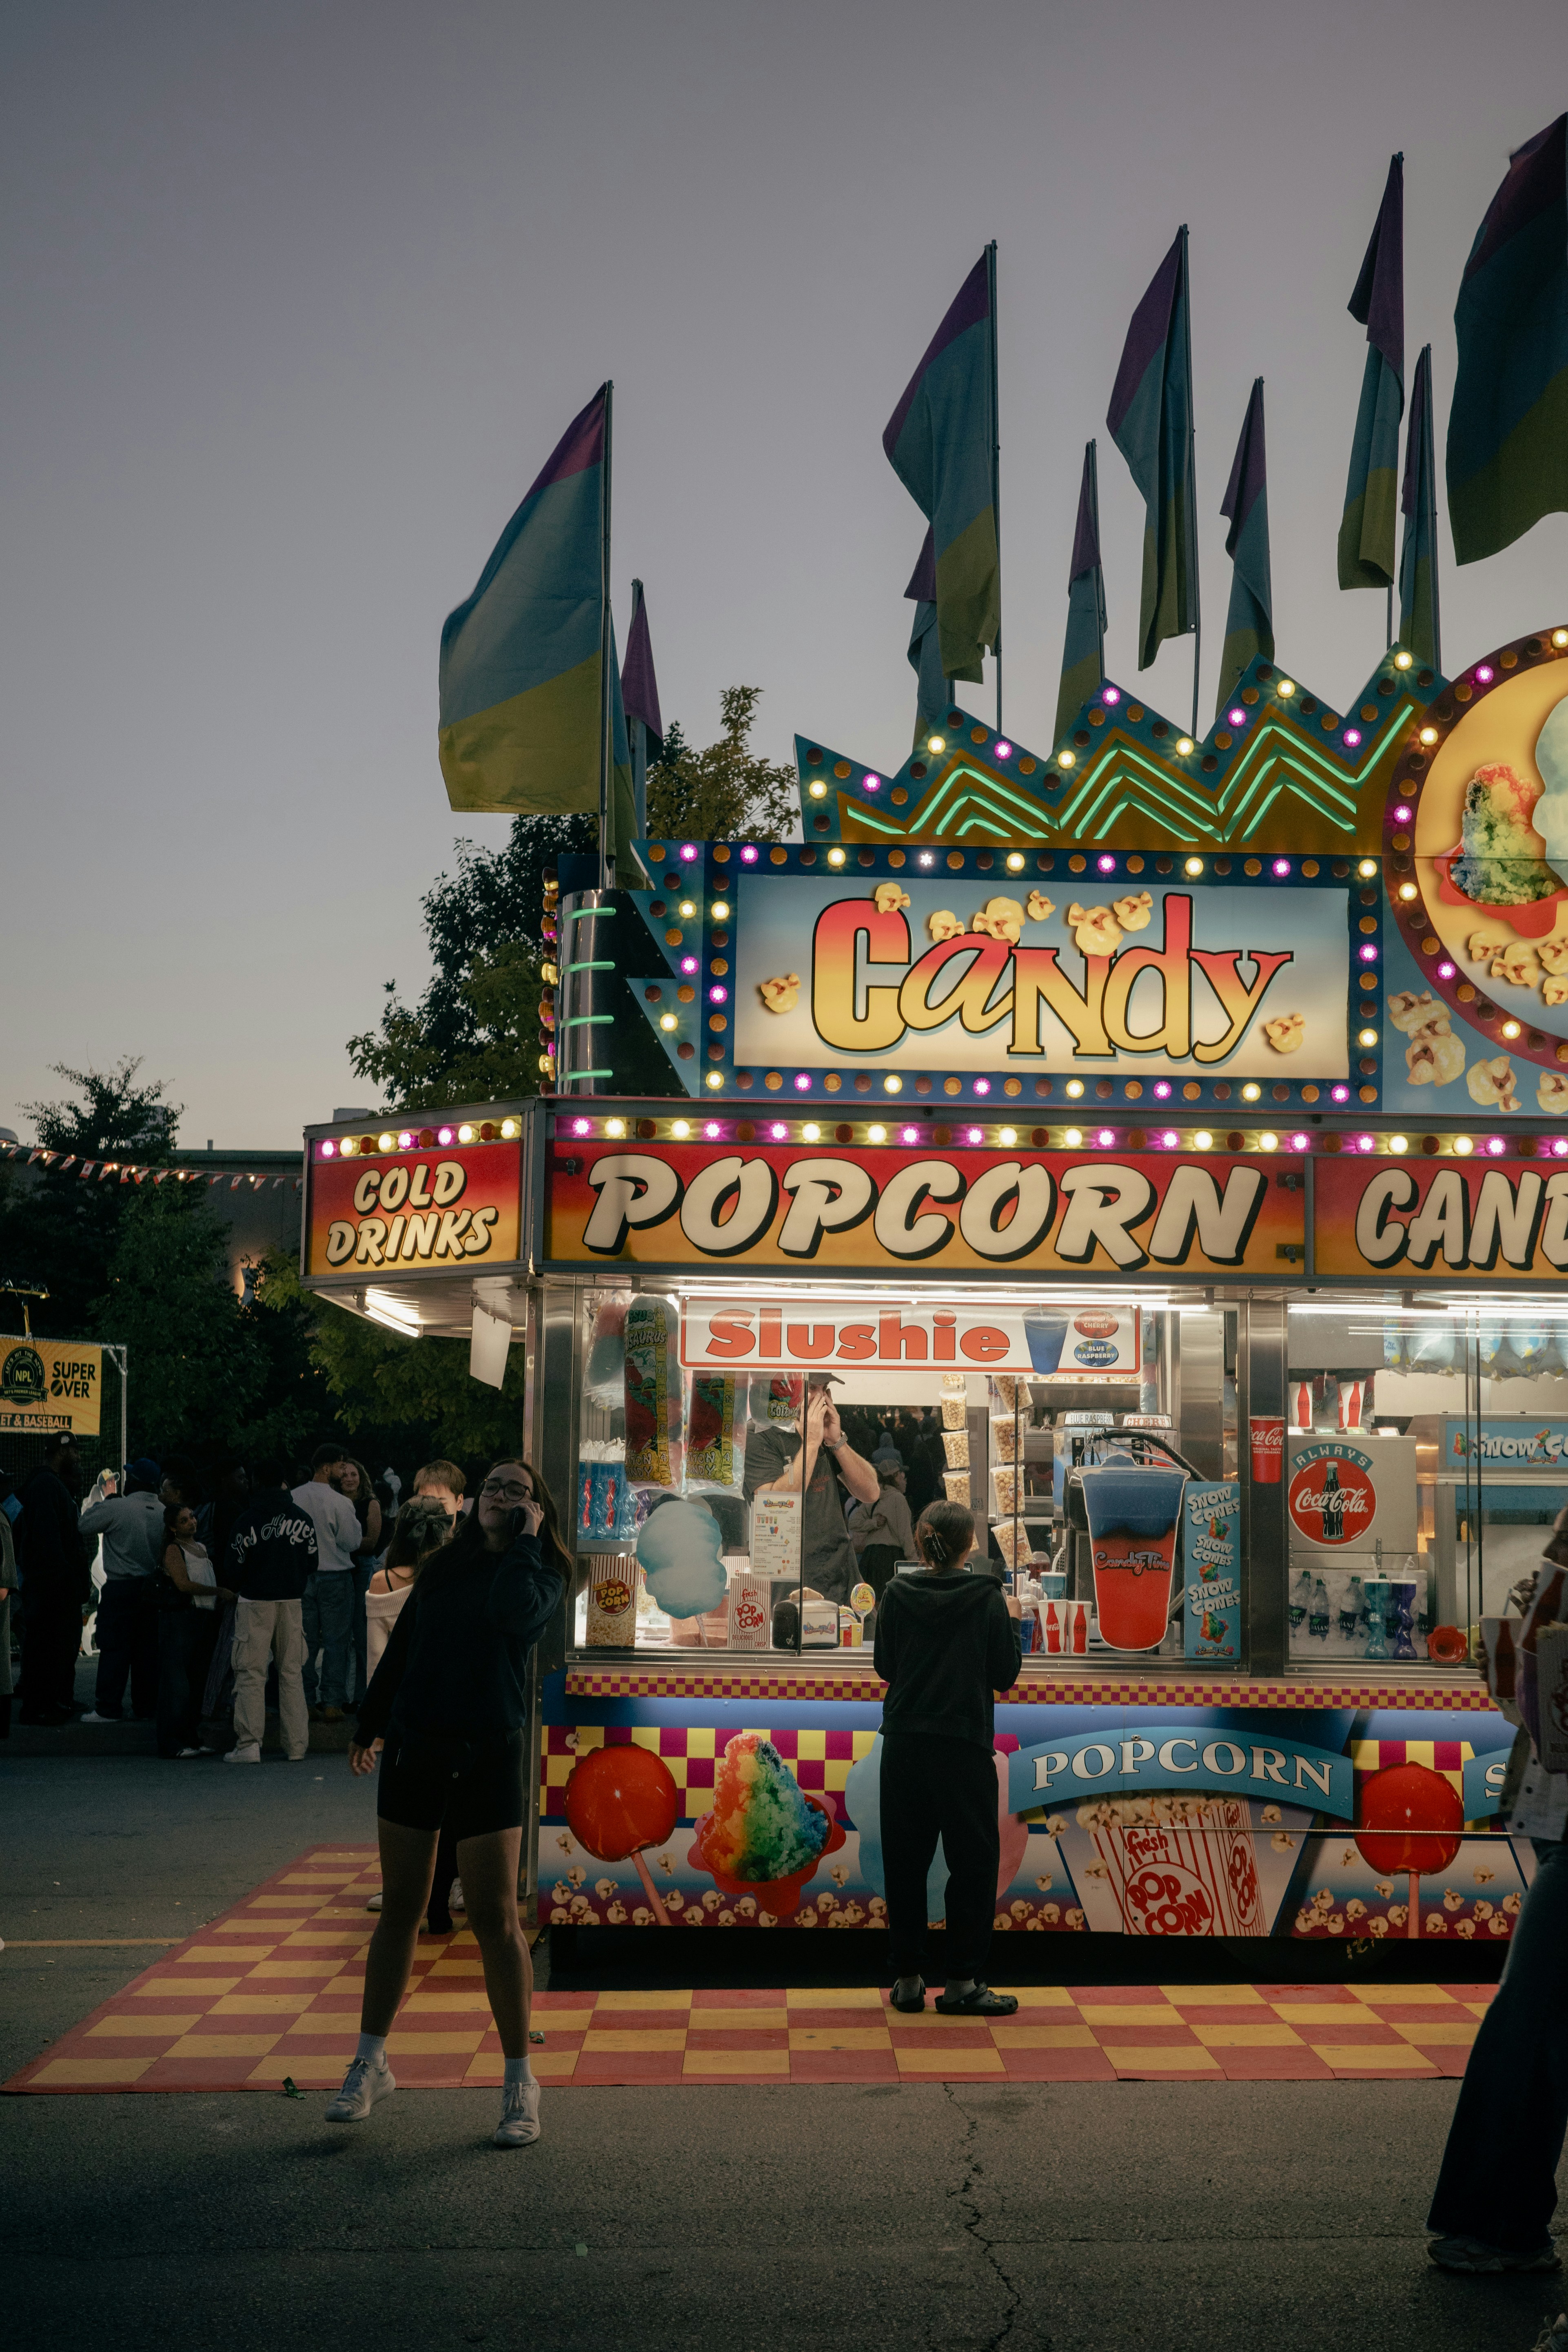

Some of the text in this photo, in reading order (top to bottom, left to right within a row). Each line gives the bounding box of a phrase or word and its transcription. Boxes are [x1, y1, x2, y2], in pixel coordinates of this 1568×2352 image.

[353, 1160, 467, 1215] COLD
[582, 1154, 1268, 1271] POPCORN
[325, 1206, 498, 1266] DRINKS
[706, 1308, 1011, 1362] Slushie
[16, 1369, 32, 1382] NPL
[52, 1361, 95, 1380] SUPER
[658, 1395, 666, 1404] 12
[725, 1395, 733, 1403] 12
[14, 1414, 22, 1427] &
[24, 1415, 69, 1428] BASEBALL
[659, 1423, 666, 1433] 8
[724, 1423, 731, 1433] 8
[1071, 1414, 1113, 1424] BLUE RASPBERRY
[1296, 1445, 1368, 1467] ALWAYS
[1473, 1432, 1541, 1459] SNOW
[660, 1452, 668, 1462] 4
[723, 1452, 731, 1462] 4
[1187, 1486, 1232, 1512] SNOW
[1295, 1487, 1368, 1513] Coca-Cola
[1191, 1498, 1240, 1526] CONES
[1196, 1534, 1234, 1555] SNOW
[1191, 1547, 1234, 1567] CONES
[593, 1582, 606, 1590] Fresh
[601, 1586, 624, 1598] POP
[742, 1588, 757, 1601] fresh
[1188, 1578, 1234, 1603] SNOW
[599, 1594, 630, 1609] CORN
[736, 1603, 757, 1618] POP
[1191, 1589, 1241, 1616] CONES
[739, 1612, 764, 1629] CORN
[1032, 1738, 1333, 1798] POPCORN
[1127, 1829, 1169, 1866] fresh
[1229, 1845, 1248, 1894] POP
[1127, 1871, 1182, 1914] POP
[1237, 1856, 1258, 1919] CORN
[1145, 1889, 1212, 1936] CORN
